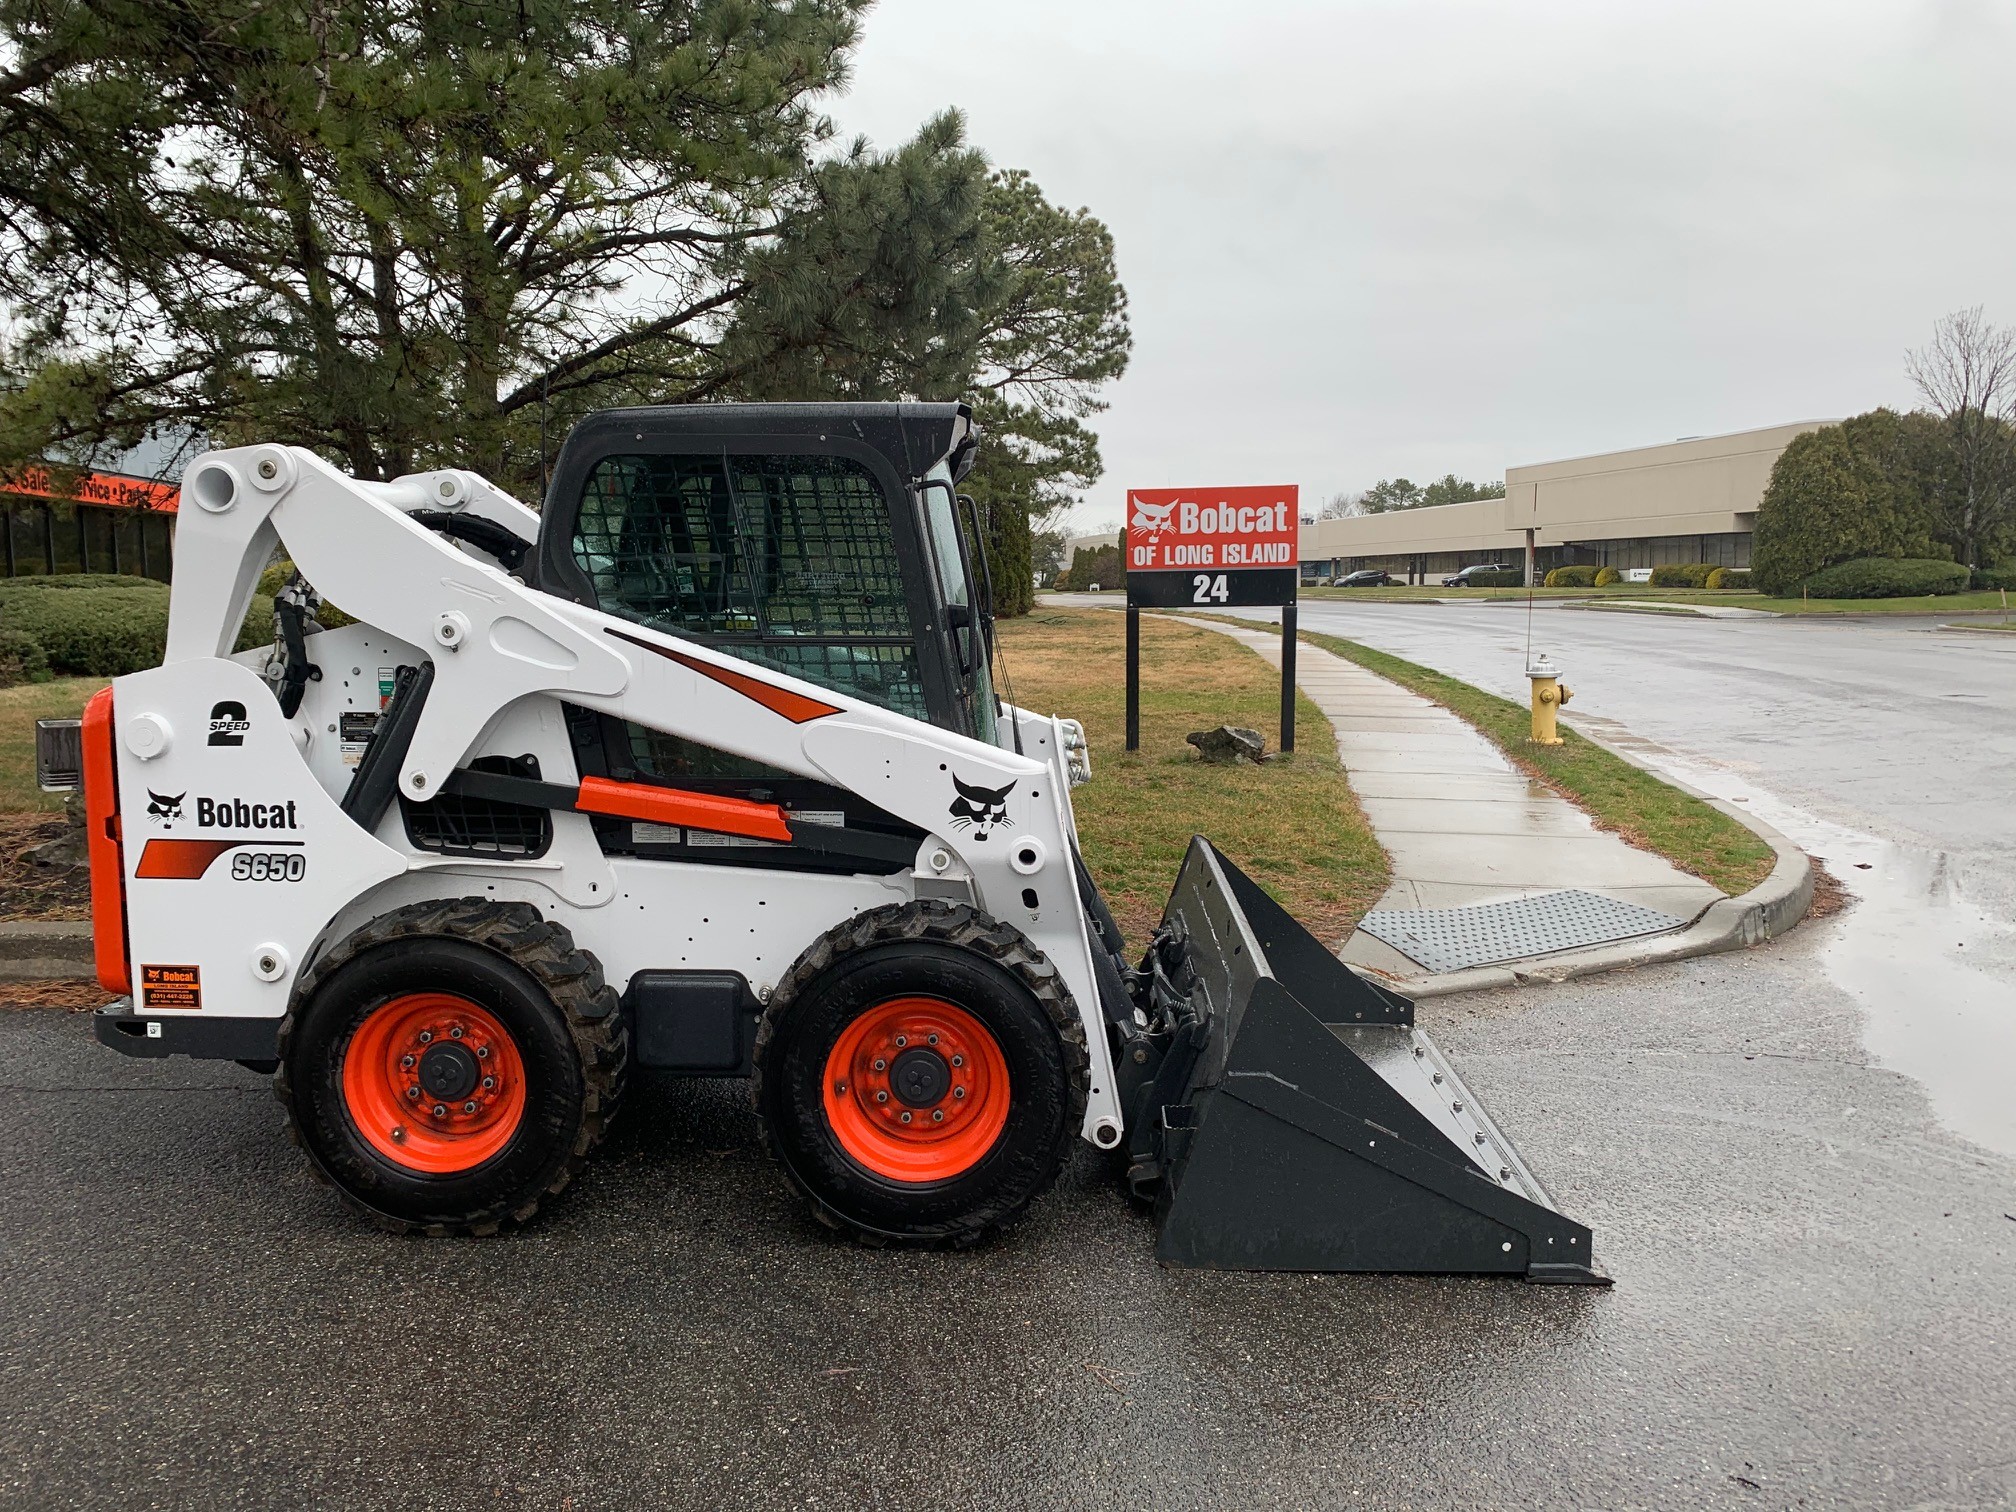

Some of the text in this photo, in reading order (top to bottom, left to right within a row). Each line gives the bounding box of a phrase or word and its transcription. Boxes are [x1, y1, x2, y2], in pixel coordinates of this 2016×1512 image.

[19, 468, 51, 492] Sale
[70, 476, 110, 500] ervice
[1179, 501, 1288, 535] Bobcat
[1133, 542, 1291, 567] OF LONG ISLAND
[1193, 574, 1229, 603] 24
[207, 700, 247, 747] 2
[209, 721, 251, 731] SPEED
[196, 797, 297, 830] Bobcat
[231, 852, 306, 882] S650
[162, 971, 194, 982] Bobcat
